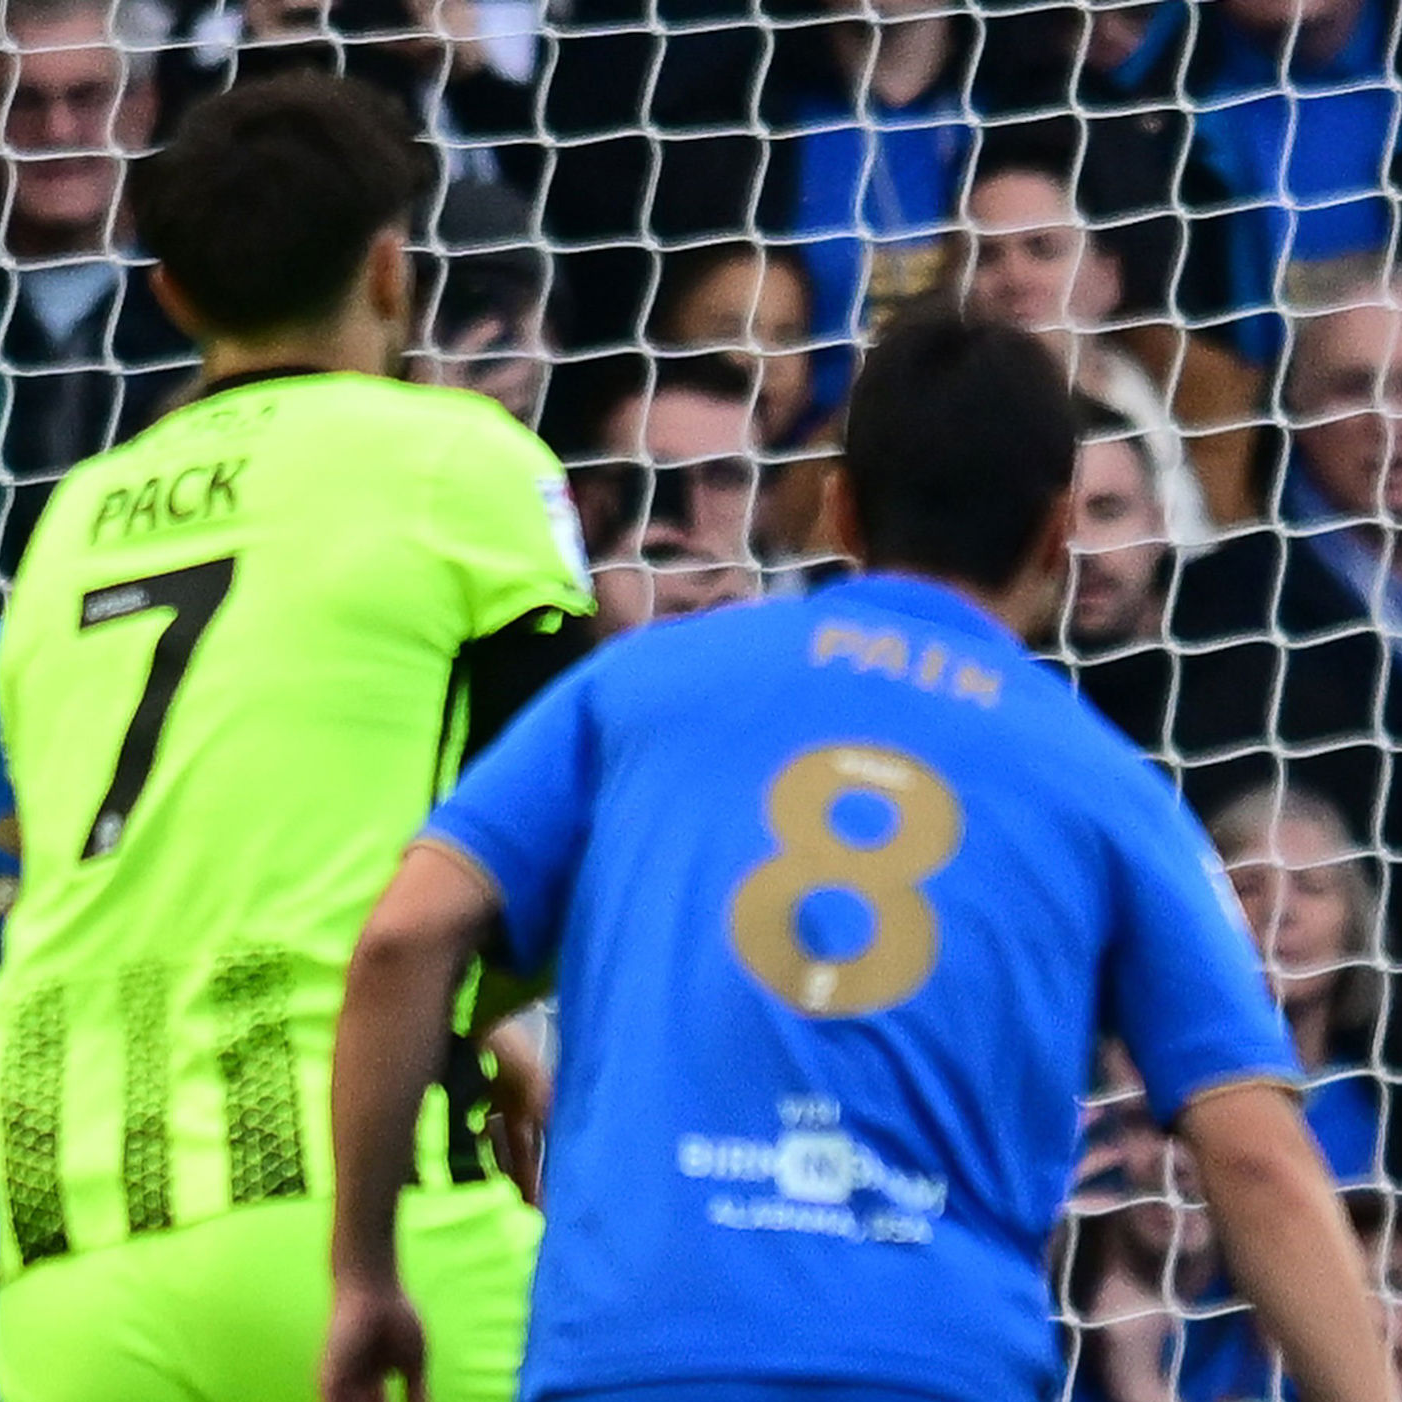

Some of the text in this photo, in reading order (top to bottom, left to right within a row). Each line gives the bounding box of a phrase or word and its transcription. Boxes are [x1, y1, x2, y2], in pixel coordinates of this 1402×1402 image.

[89, 457, 248, 546] PACK
[79, 556, 237, 863] 7
[727, 742, 967, 1020] 8
